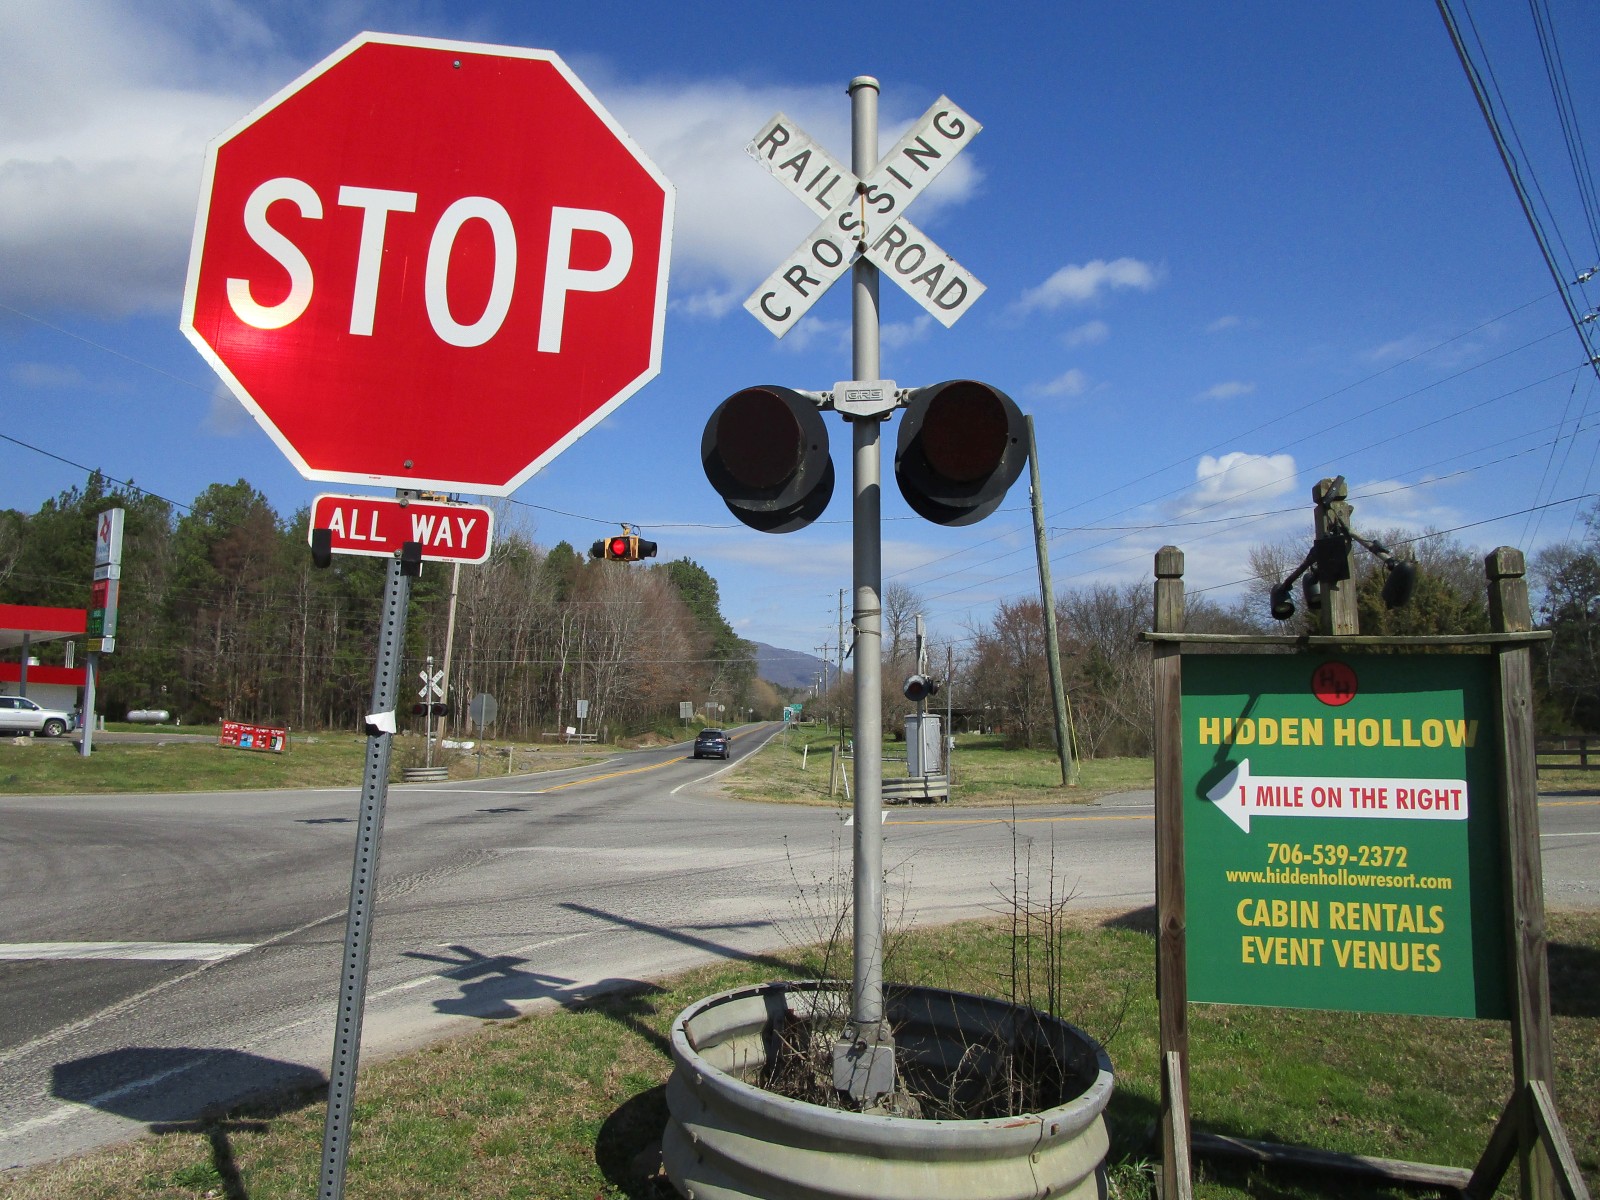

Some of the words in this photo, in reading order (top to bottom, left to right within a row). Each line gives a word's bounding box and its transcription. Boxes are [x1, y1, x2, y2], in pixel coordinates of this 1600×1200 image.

[757, 123, 841, 211] RAIL
[872, 224, 968, 310] ROAD
[760, 111, 966, 322] CROSSING
[226, 177, 634, 354] STOP
[328, 507, 387, 542] ALL
[411, 513, 477, 549] WAY
[1199, 717, 1324, 746] HIDDEN
[1334, 718, 1479, 748] HOLLOW
[1238, 785, 1246, 806] 1
[1256, 786, 1304, 808] MILE
[1311, 786, 1342, 808] ON
[1349, 787, 1388, 809] THE
[1396, 788, 1462, 811] RIGHT
[1267, 843, 1408, 868] 706-539-2372
[1226, 867, 1452, 890] www.hiddenhollowresort.com
[1236, 898, 1320, 929] CABIN
[1329, 902, 1446, 934] RENTALS
[1241, 936, 1324, 967] EVENT
[1331, 940, 1442, 973] VENUES
